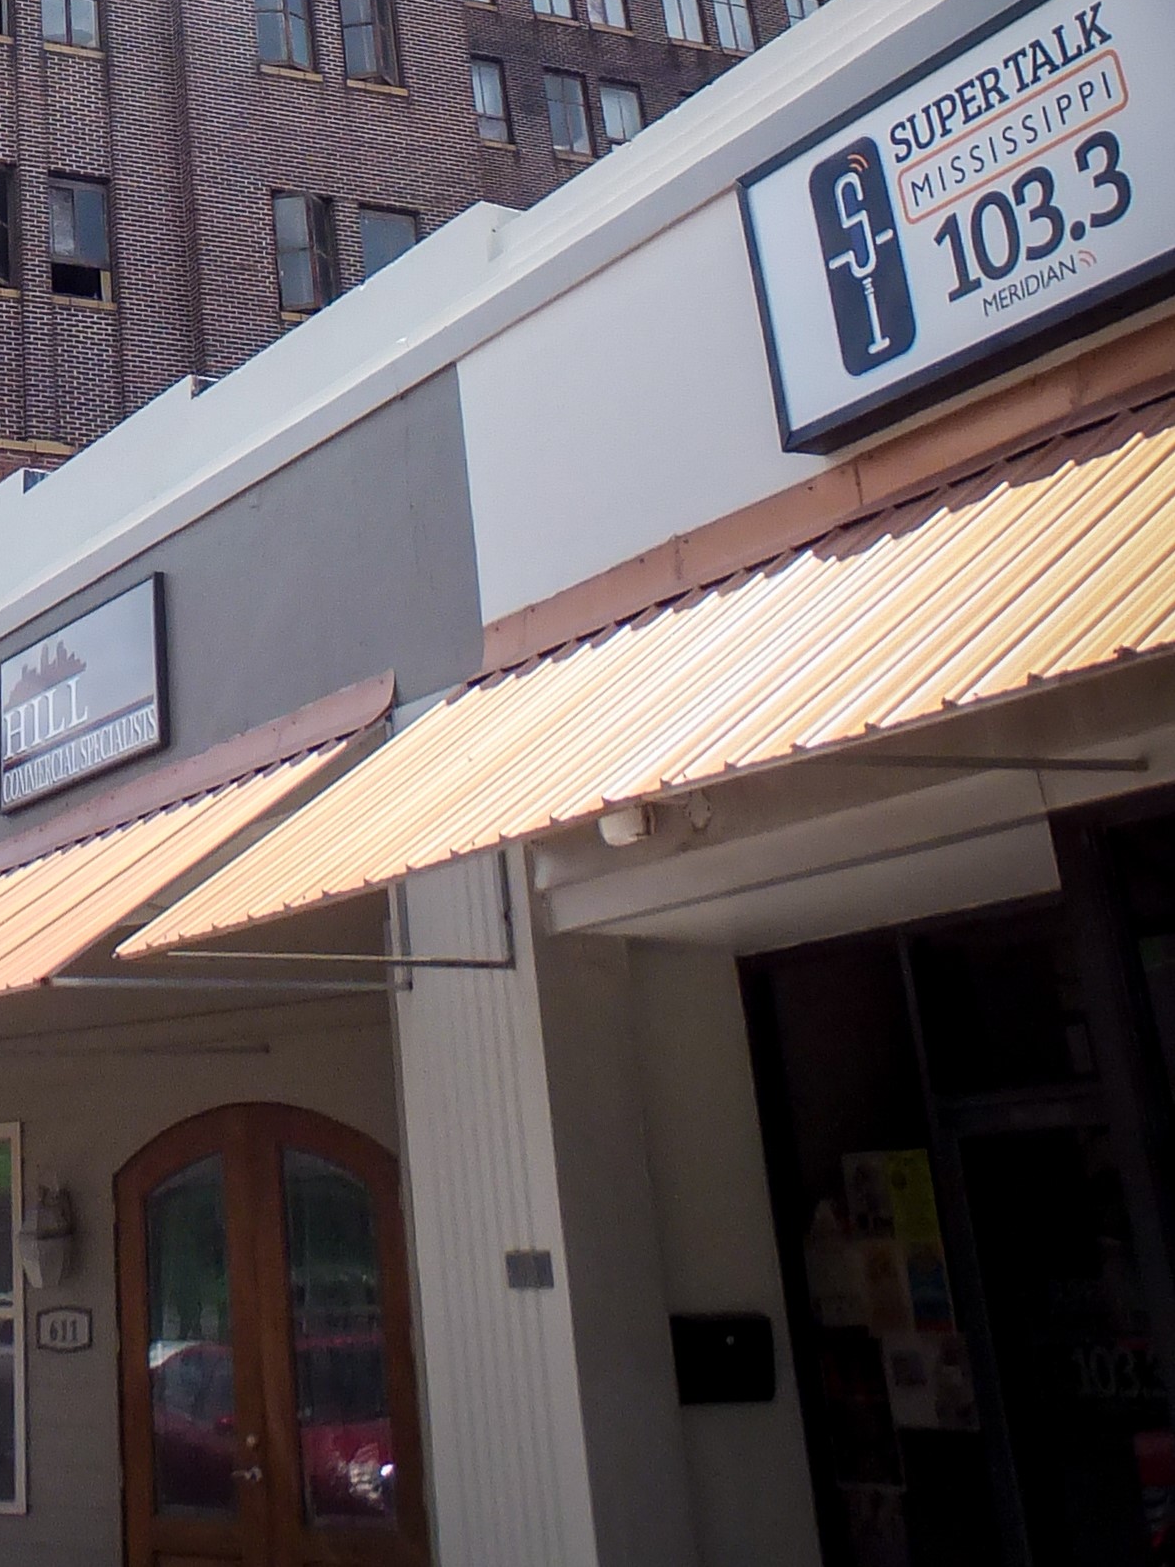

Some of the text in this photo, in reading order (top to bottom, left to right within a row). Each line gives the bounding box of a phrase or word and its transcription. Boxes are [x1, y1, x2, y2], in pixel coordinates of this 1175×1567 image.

[889, 2, 1113, 164] SUPERTALK
[910, 71, 1113, 207] MISSISSIPPI
[933, 130, 1132, 303] 103.3
[982, 255, 1077, 317] MERIDIAN
[2, 705, 157, 803] COMMERCIAL SPECIALISTS
[3, 676, 88, 760] HILL
[50, 1319, 77, 1342] 611
